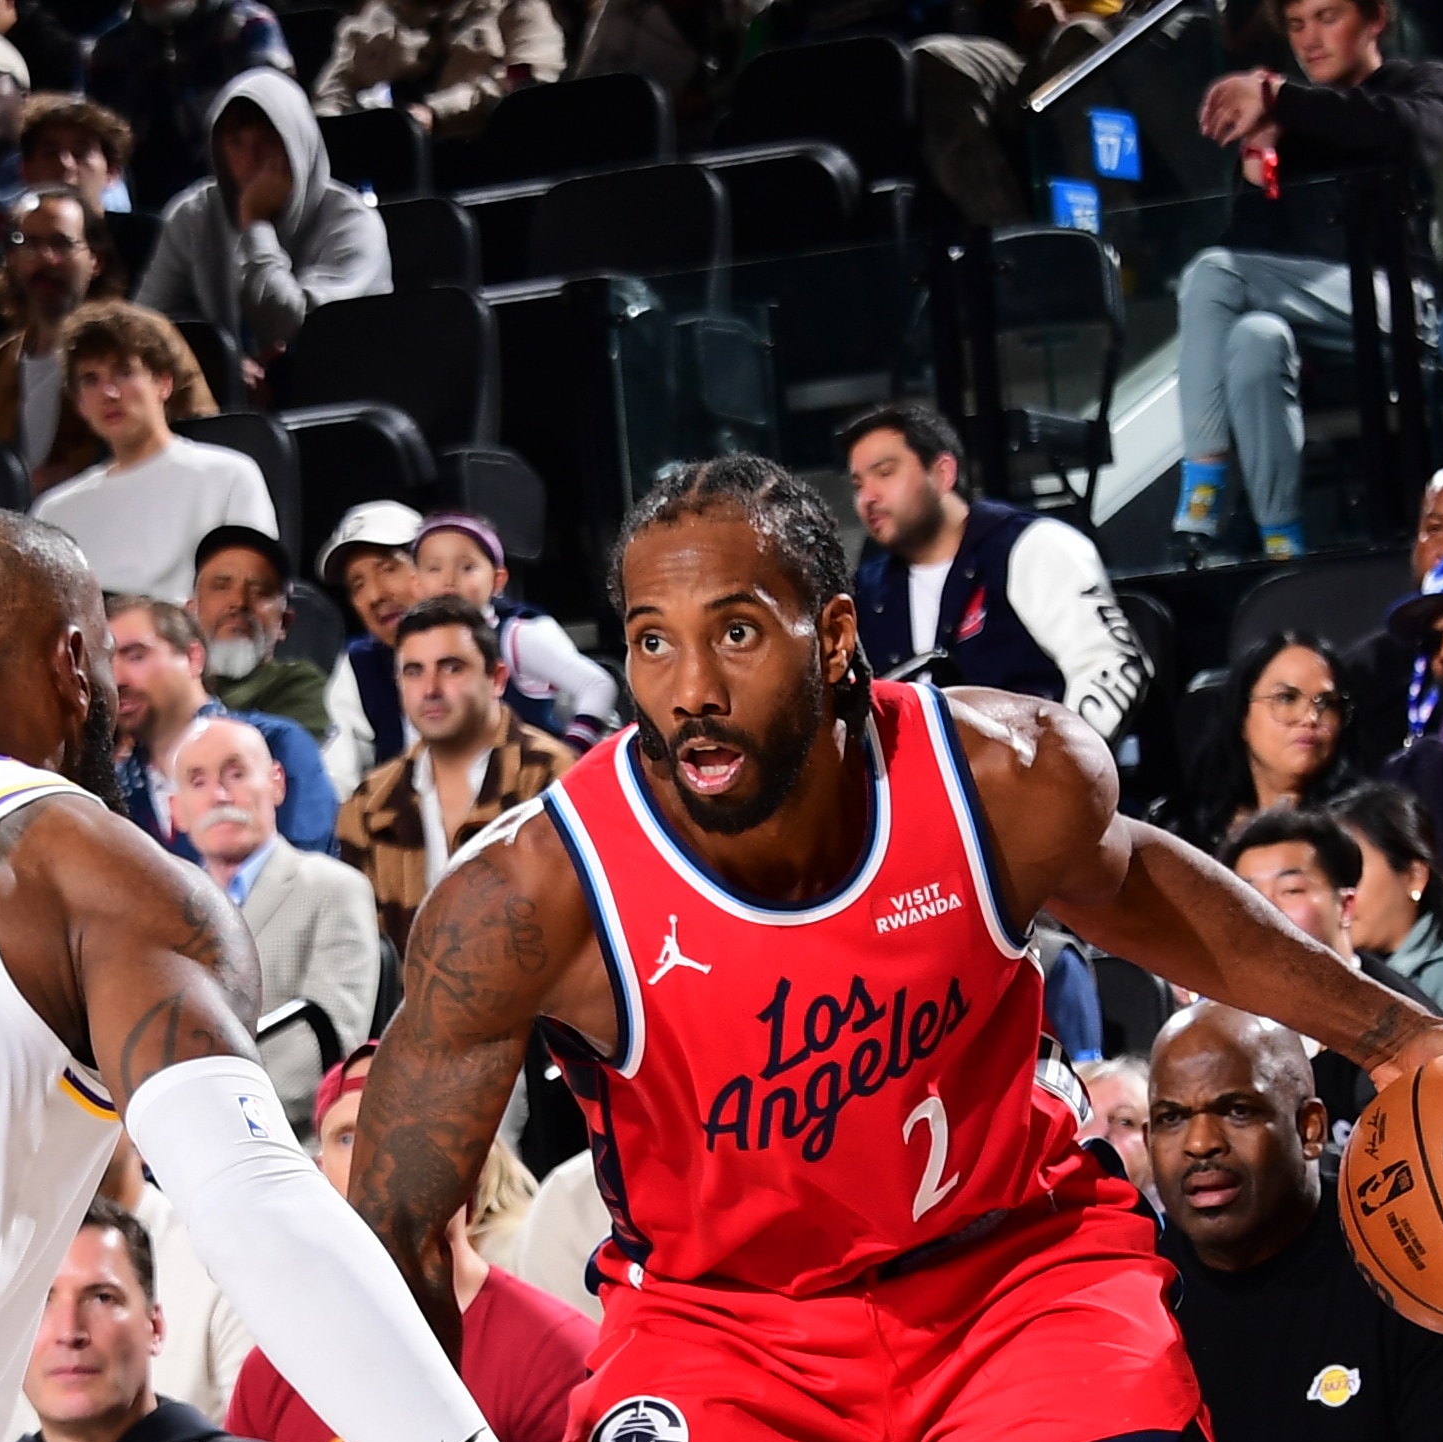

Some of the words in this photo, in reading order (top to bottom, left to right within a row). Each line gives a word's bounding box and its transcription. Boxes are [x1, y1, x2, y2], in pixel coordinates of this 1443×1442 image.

[875, 893, 963, 934] RWANDA
[890, 882, 940, 911] VISIT
[702, 976, 972, 1162] Angeles
[757, 974, 887, 1080] Los
[902, 1095, 960, 1222] 2
